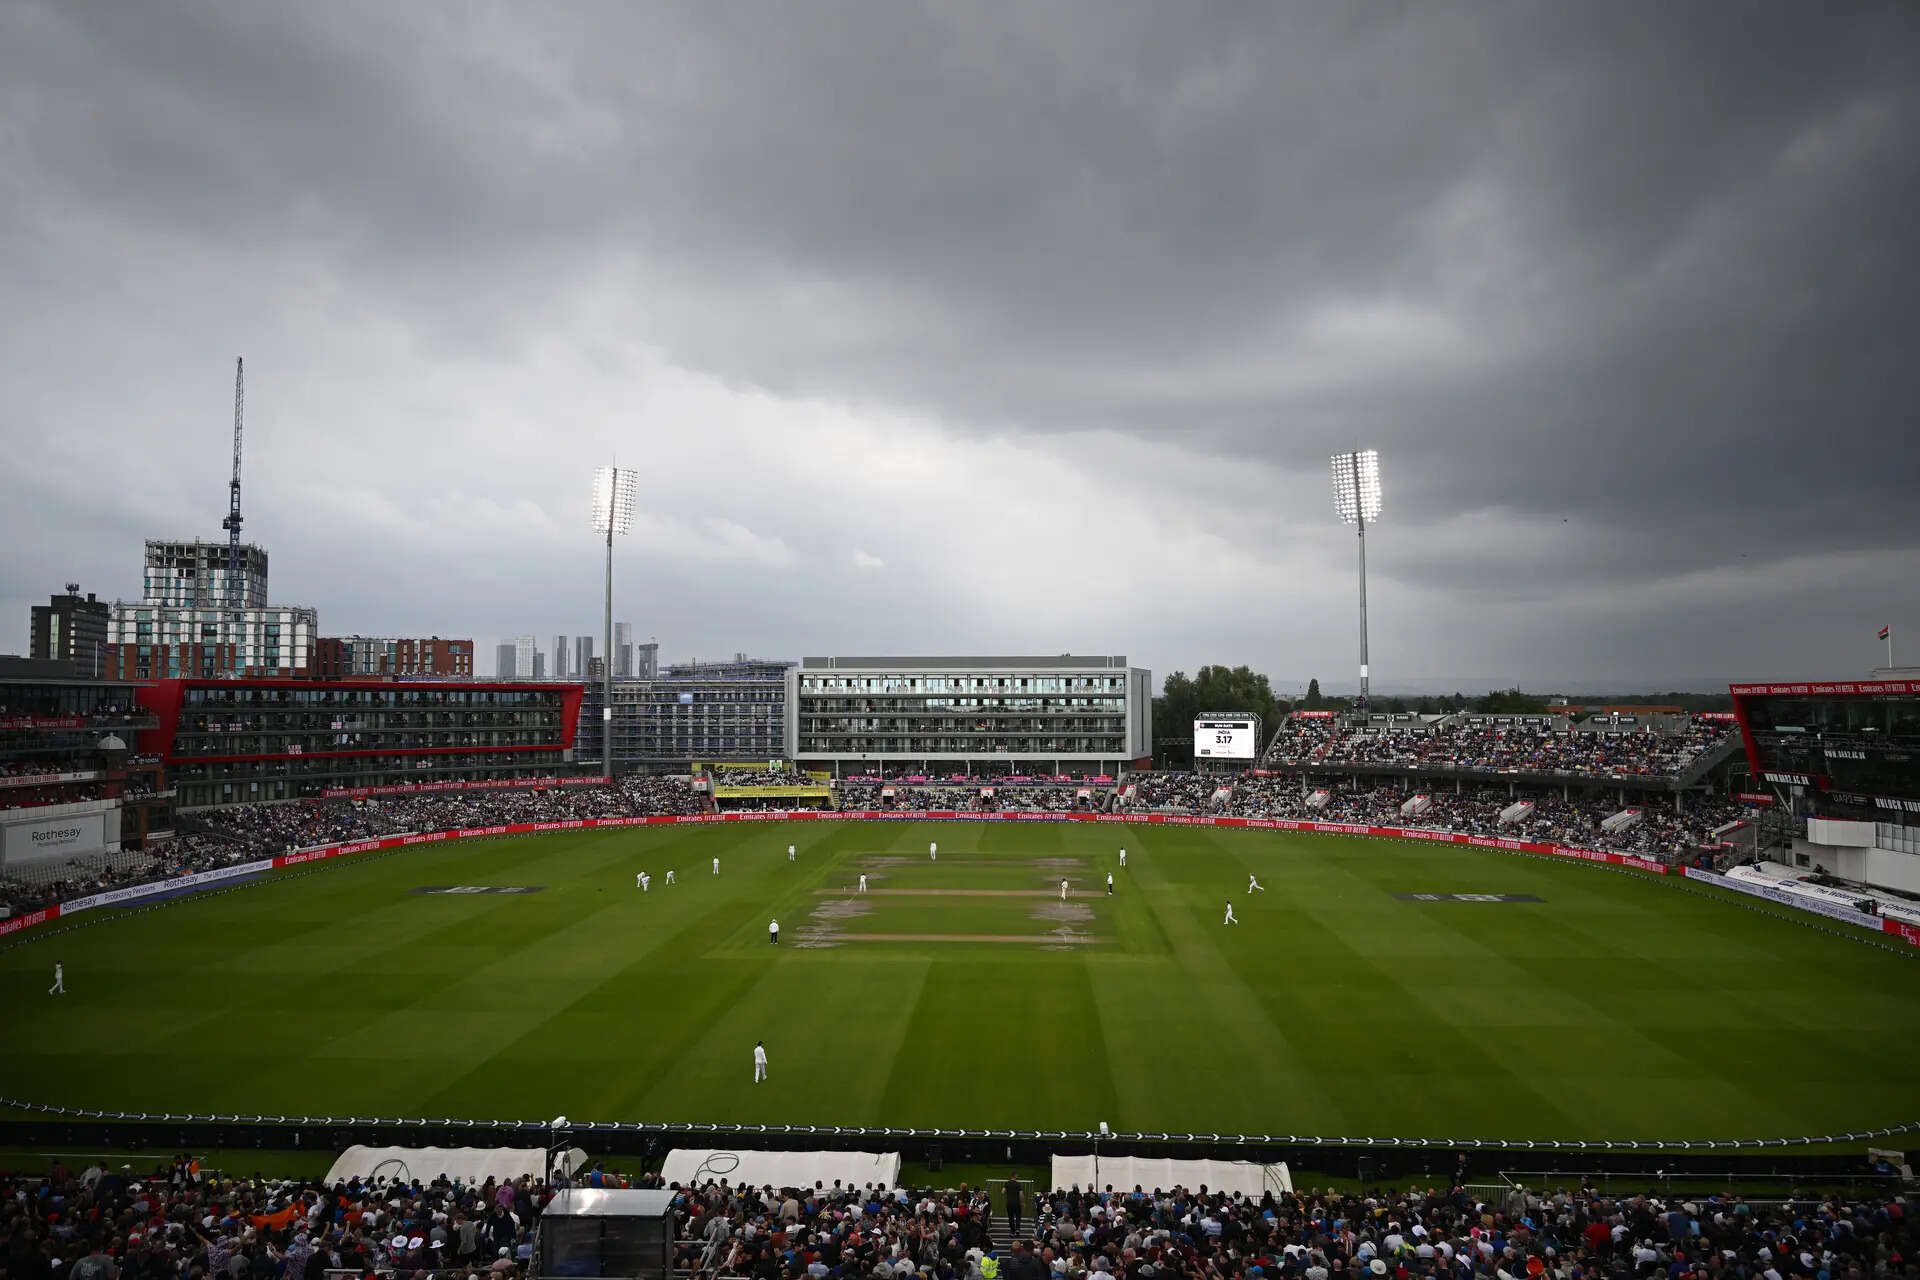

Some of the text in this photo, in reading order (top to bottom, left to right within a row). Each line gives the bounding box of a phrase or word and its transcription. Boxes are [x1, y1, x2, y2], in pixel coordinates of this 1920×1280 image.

[1215, 735, 1233, 744] 3.17
[739, 813, 766, 821] Emirates
[878, 811, 904, 819] Emirates
[1017, 812, 1044, 820] Emirates
[1096, 813, 1125, 822] Emirates
[534, 822, 560, 831] Emirates
[597, 818, 624, 826] Emirates
[1246, 820, 1274, 828] Emirates
[1313, 823, 1343, 832] Emirates
[32, 827, 82, 842] Rothesay
[459, 830, 485, 838] Emirates
[1401, 830, 1430, 839] Emirates
[403, 834, 426, 844] Emirates
[1468, 836, 1496, 845] Emirates
[338, 844, 361, 855] Emirates
[1552, 846, 1581, 858] Emirates
[285, 853, 308, 865] Emirates
[164, 874, 199, 889] Rothesay
[104, 884, 156, 902] Protecting Pensions
[1762, 886, 1794, 904] Rothesay
[1815, 888, 1829, 896] The
[63, 895, 98, 912] Rothesay
[0, 918, 22, 936] mirates
